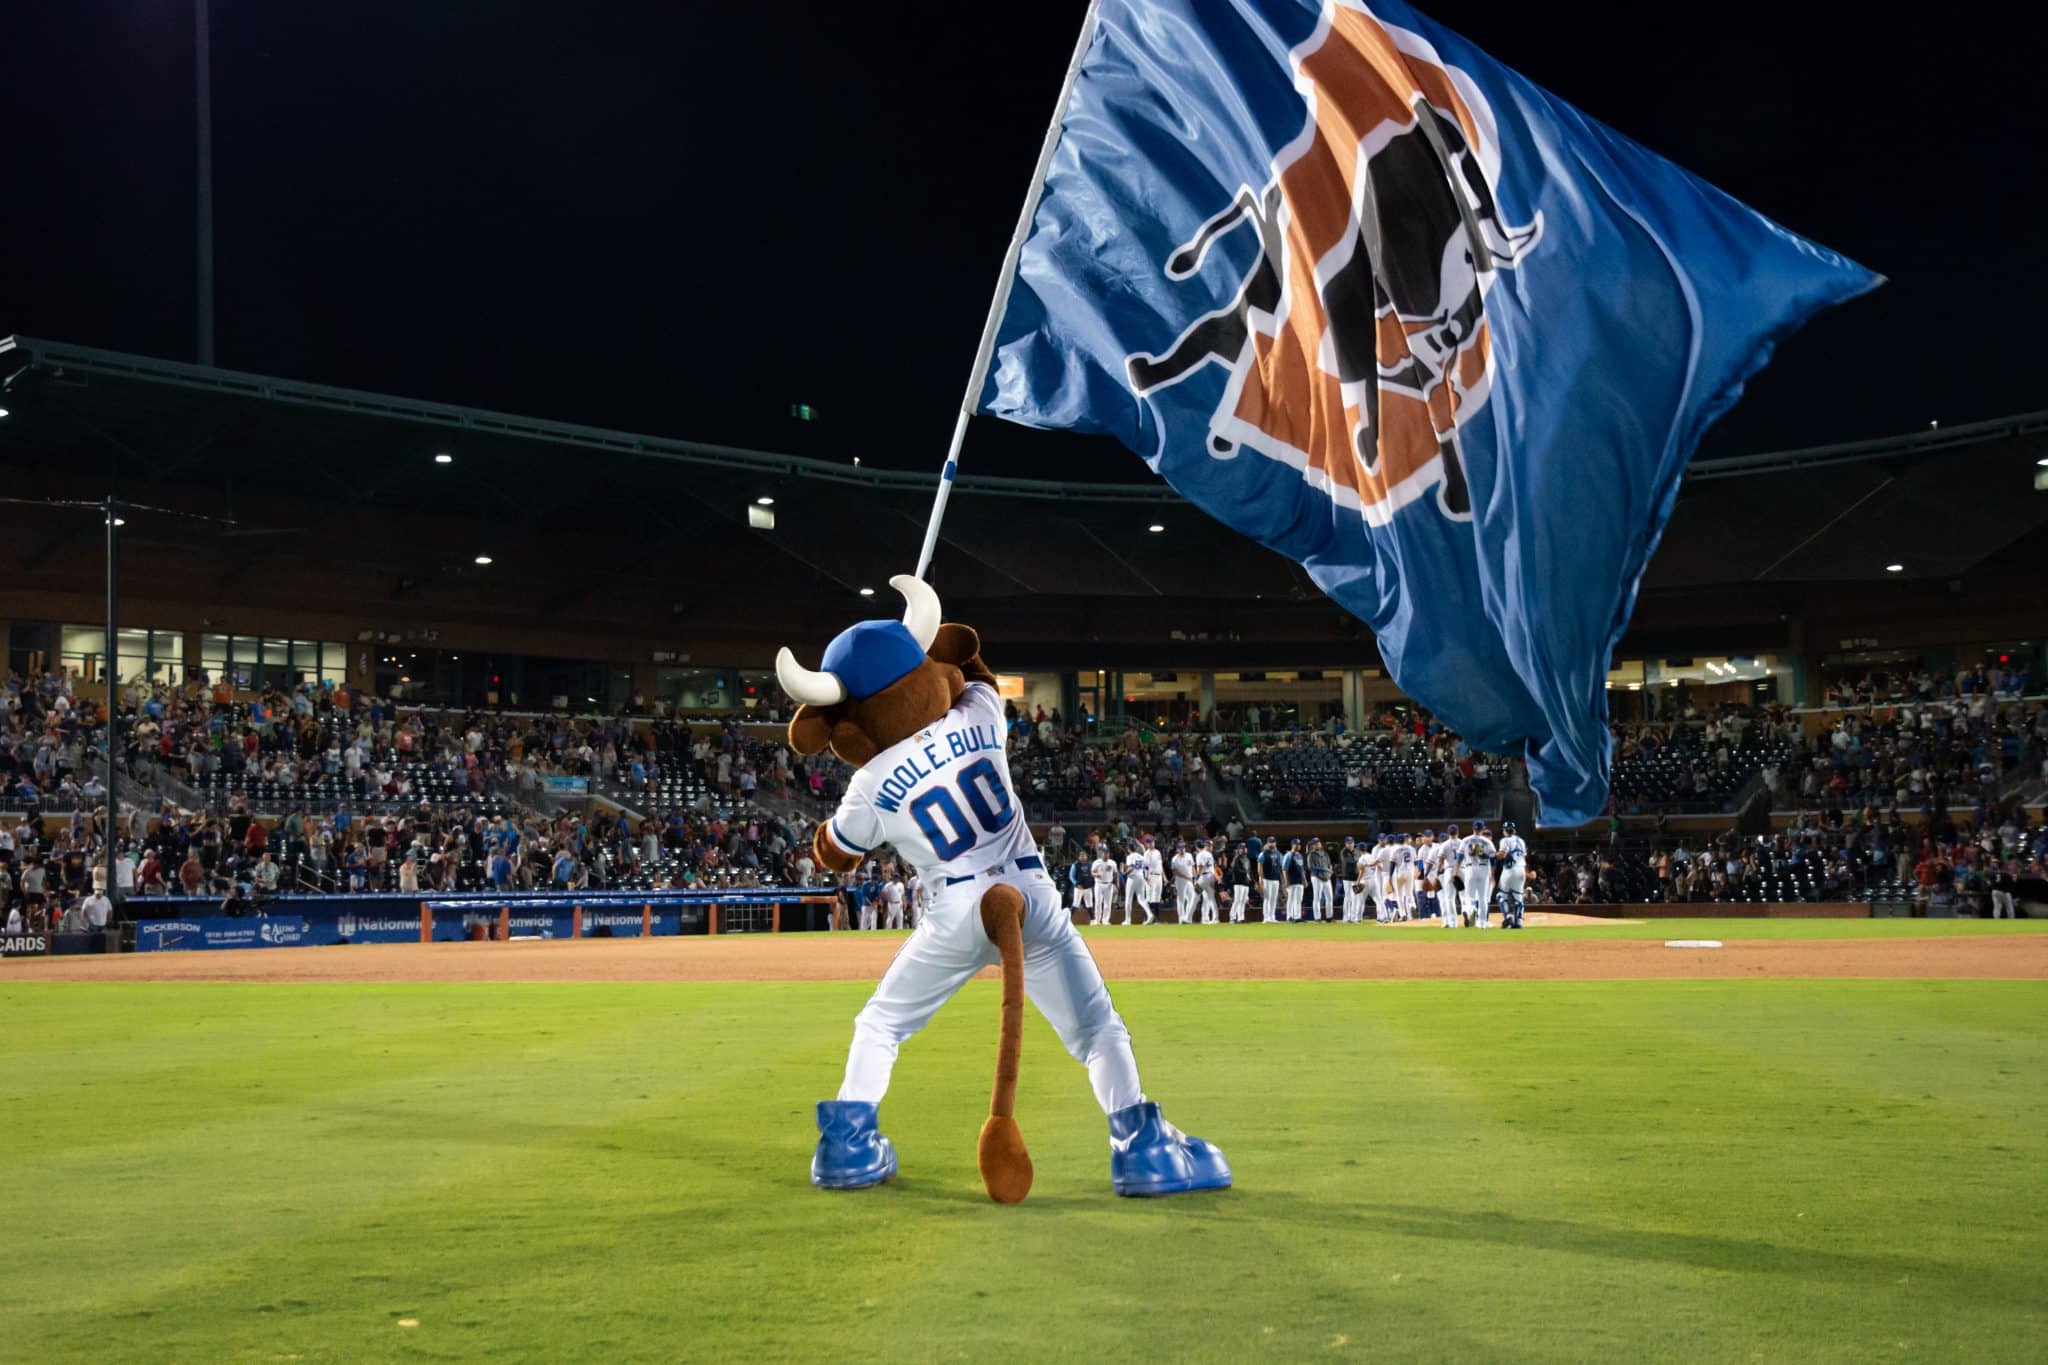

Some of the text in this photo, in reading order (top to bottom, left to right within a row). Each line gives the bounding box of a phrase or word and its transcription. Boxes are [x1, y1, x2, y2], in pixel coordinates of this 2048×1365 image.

[909, 757, 1014, 862] 00
[143, 922, 200, 933] DICKERSON
[358, 916, 437, 931] Nationwie
